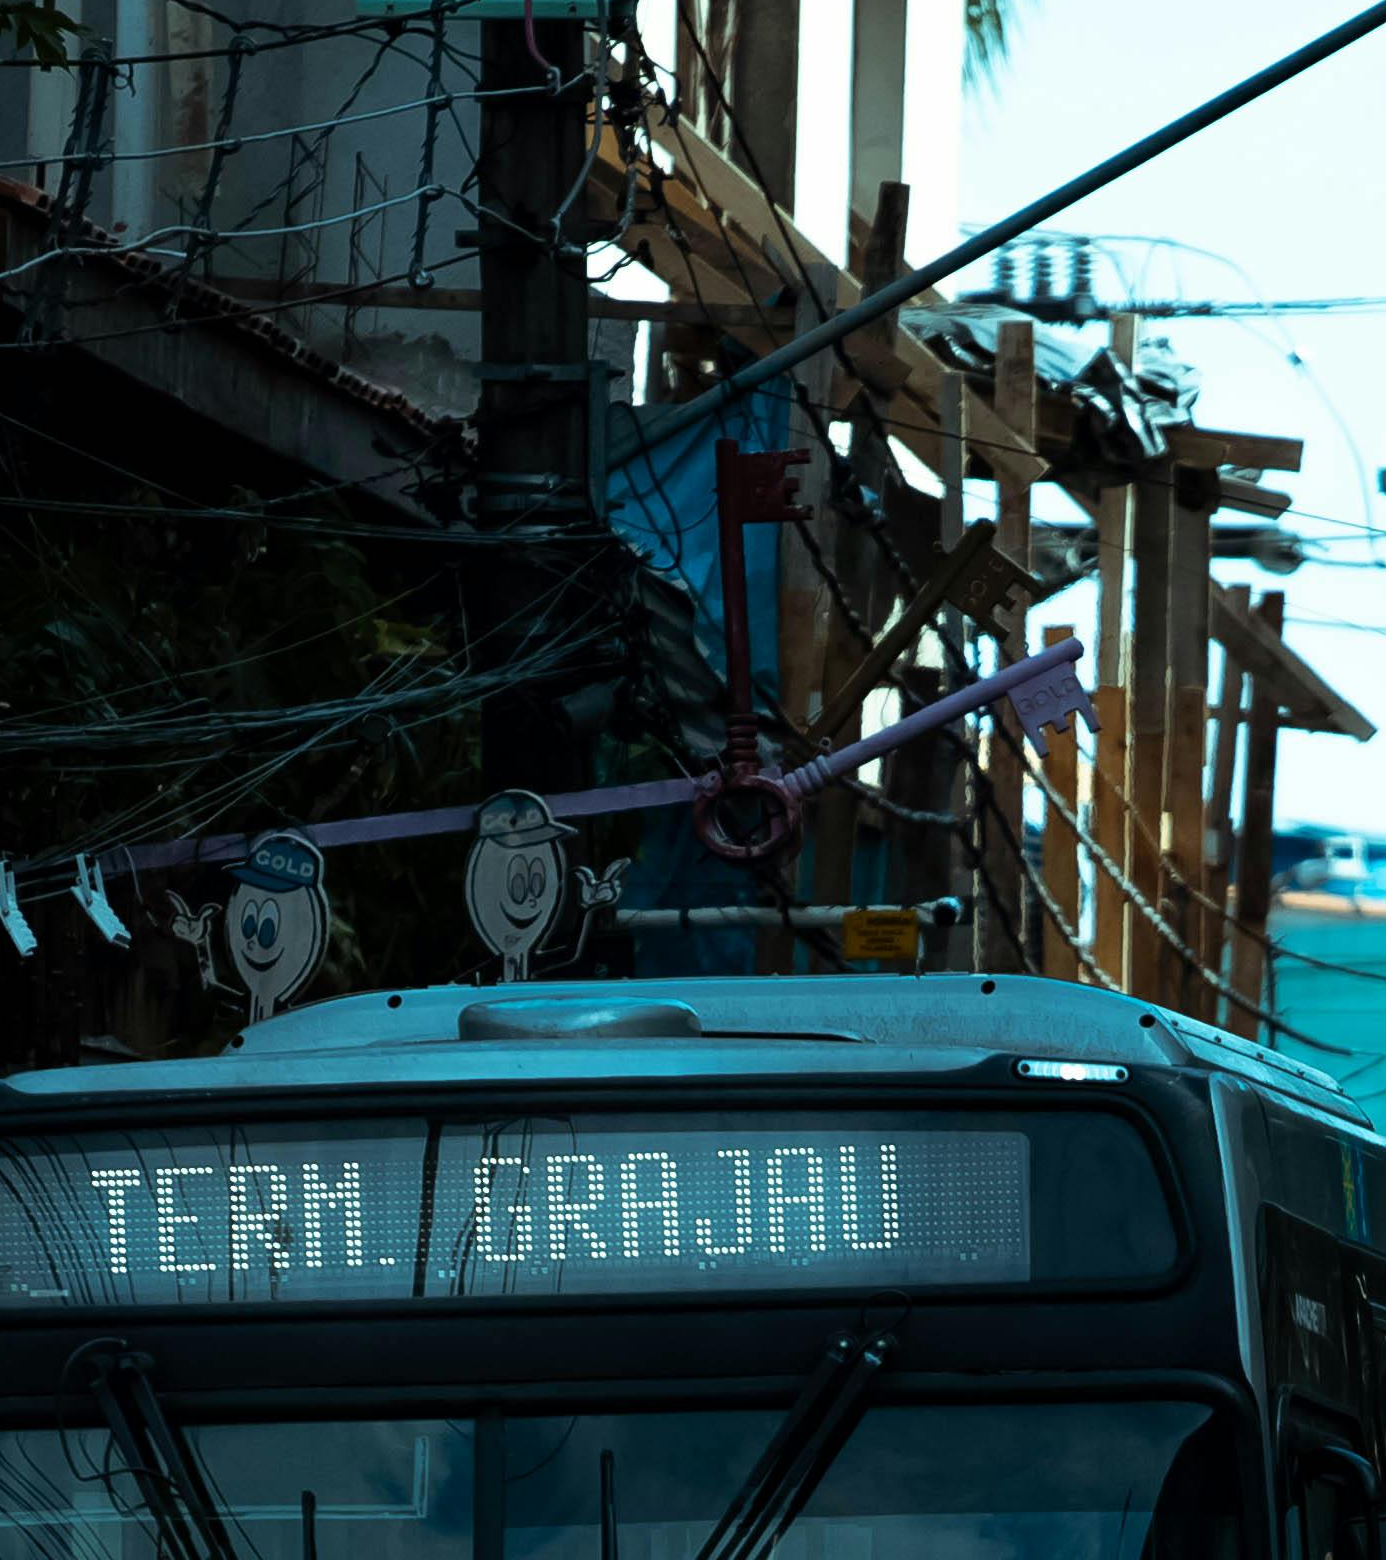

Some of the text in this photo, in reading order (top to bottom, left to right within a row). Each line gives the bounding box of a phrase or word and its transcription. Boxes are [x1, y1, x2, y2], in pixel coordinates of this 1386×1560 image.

[255, 849, 315, 878] GOLD
[90, 1144, 899, 1275] TERM. GRAJAU
